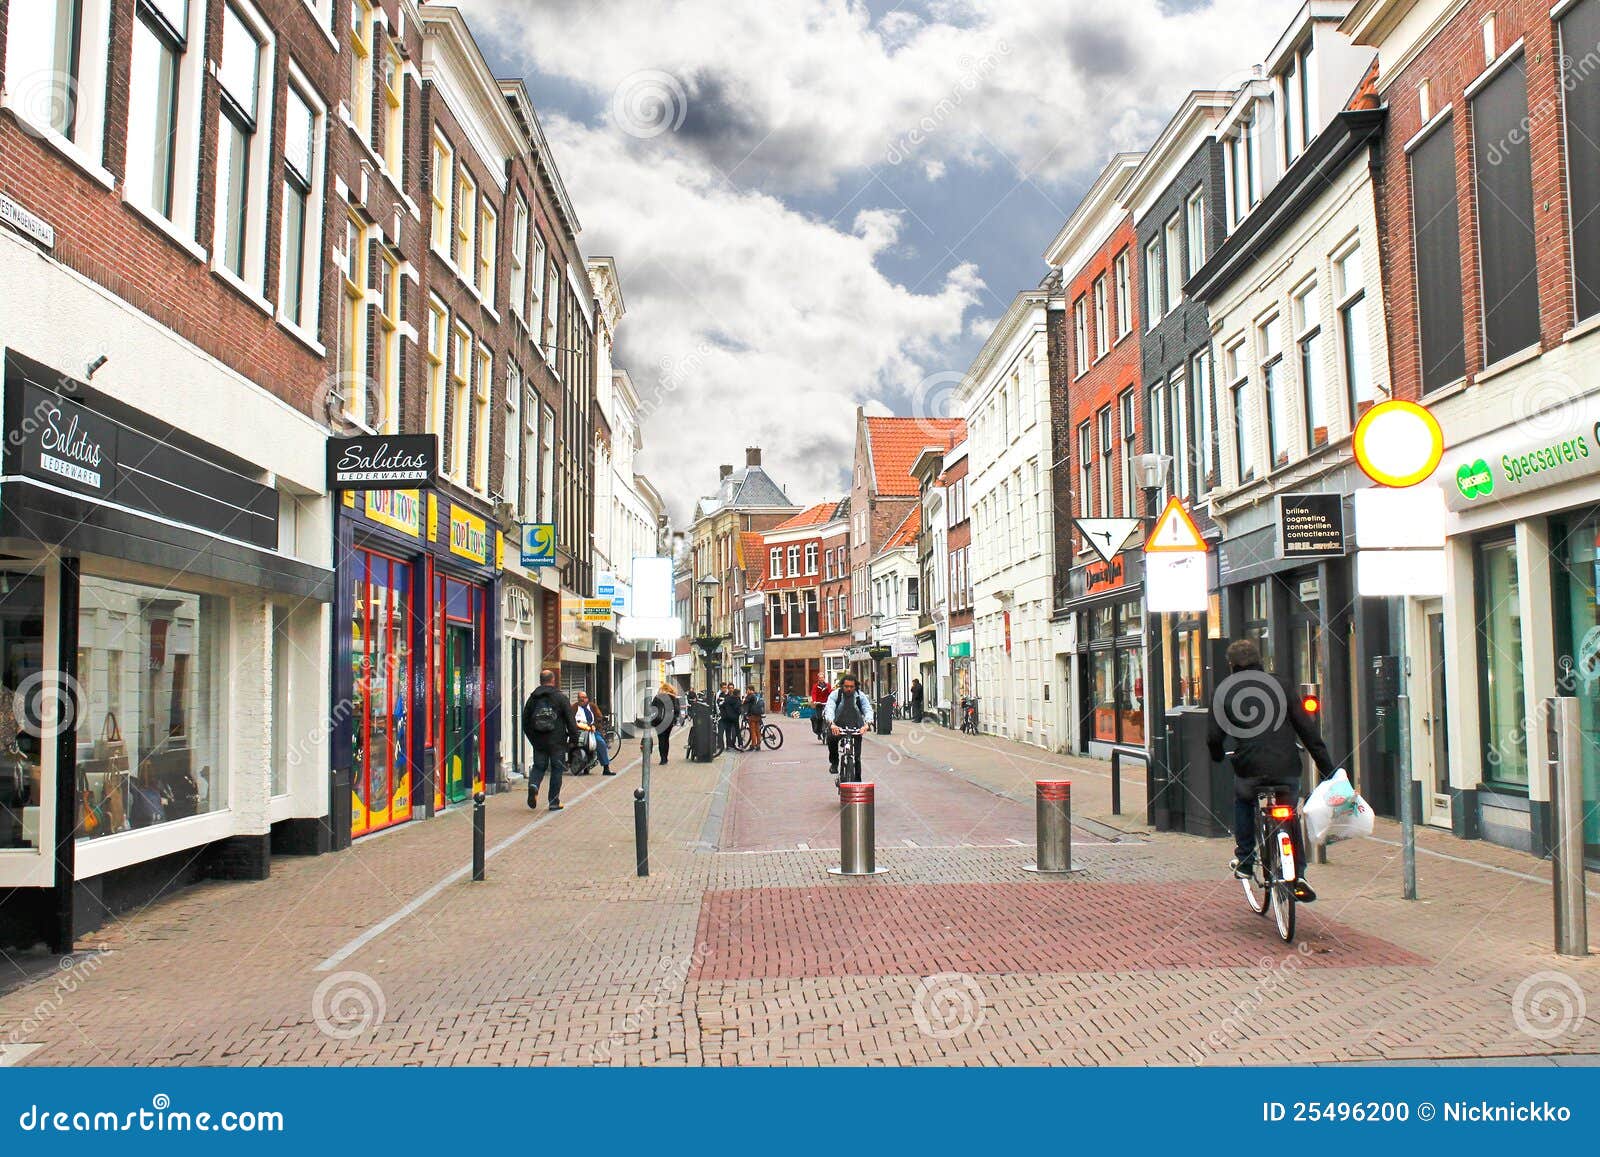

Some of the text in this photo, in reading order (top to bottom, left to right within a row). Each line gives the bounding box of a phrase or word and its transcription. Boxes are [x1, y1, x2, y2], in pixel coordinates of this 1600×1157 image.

[0, 199, 51, 240] ESTWAGENSTRAAT
[42, 409, 102, 467] Salutas
[43, 455, 99, 485] LEDERWAREN
[337, 443, 427, 470] Salutas
[1502, 436, 1589, 483] Specsavers
[341, 472, 423, 480] LEDERWAREN
[1286, 515, 1326, 523] oogmeting
